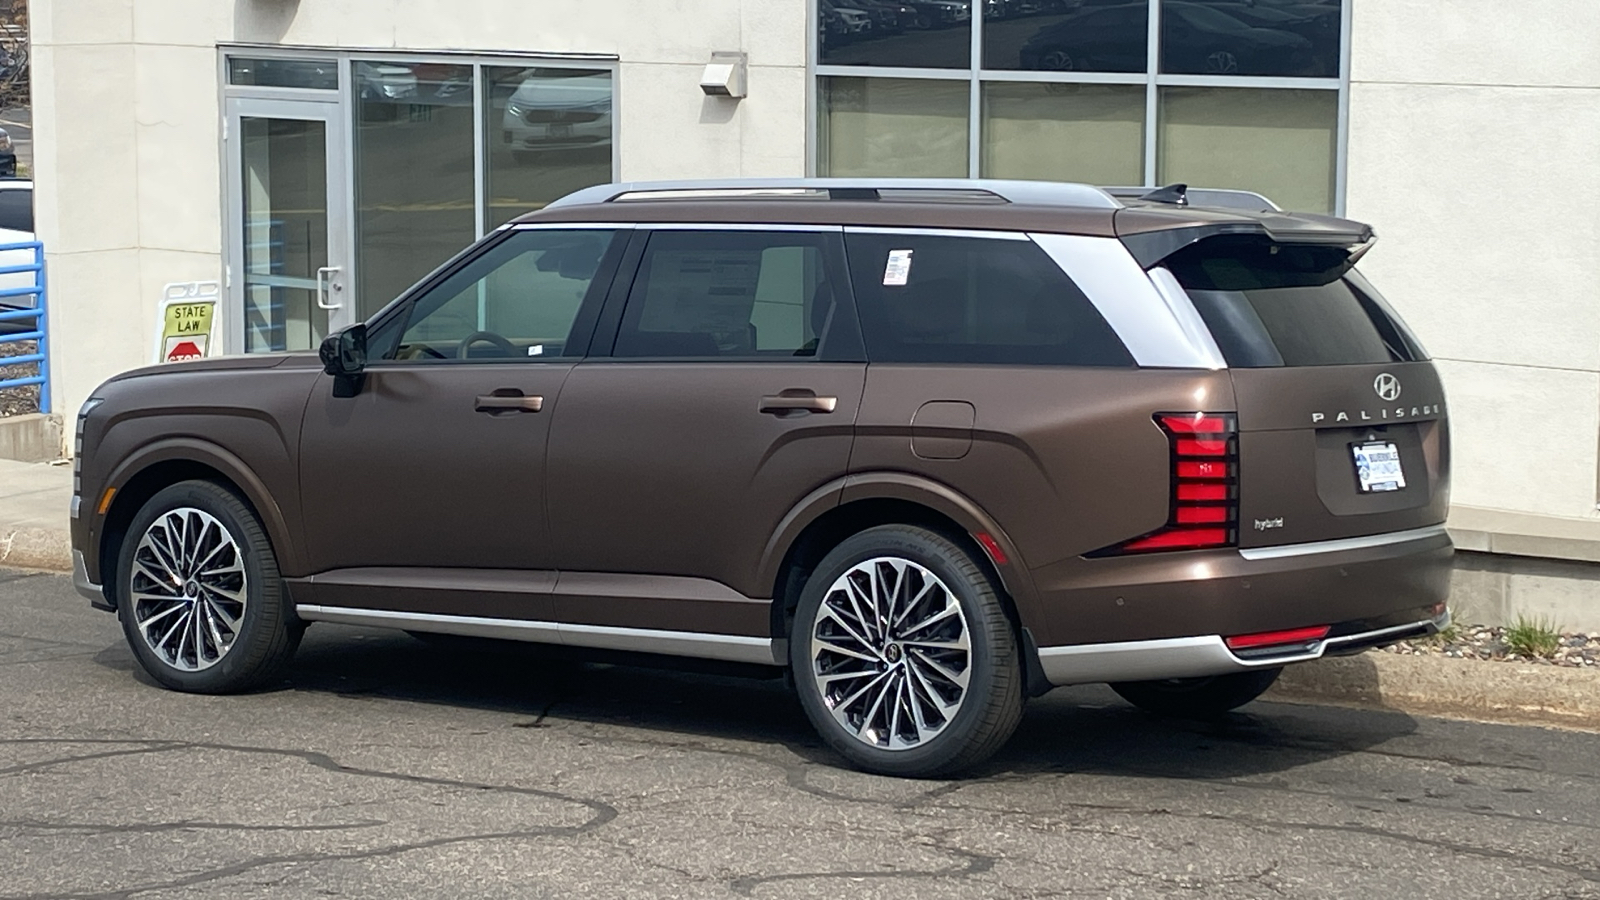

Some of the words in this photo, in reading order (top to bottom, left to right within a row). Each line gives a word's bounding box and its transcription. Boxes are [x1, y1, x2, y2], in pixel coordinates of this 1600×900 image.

[175, 306, 206, 319] STATE
[178, 320, 201, 332] LAW
[1312, 404, 1440, 423] PALISADE
[1254, 516, 1284, 531] hybrid
